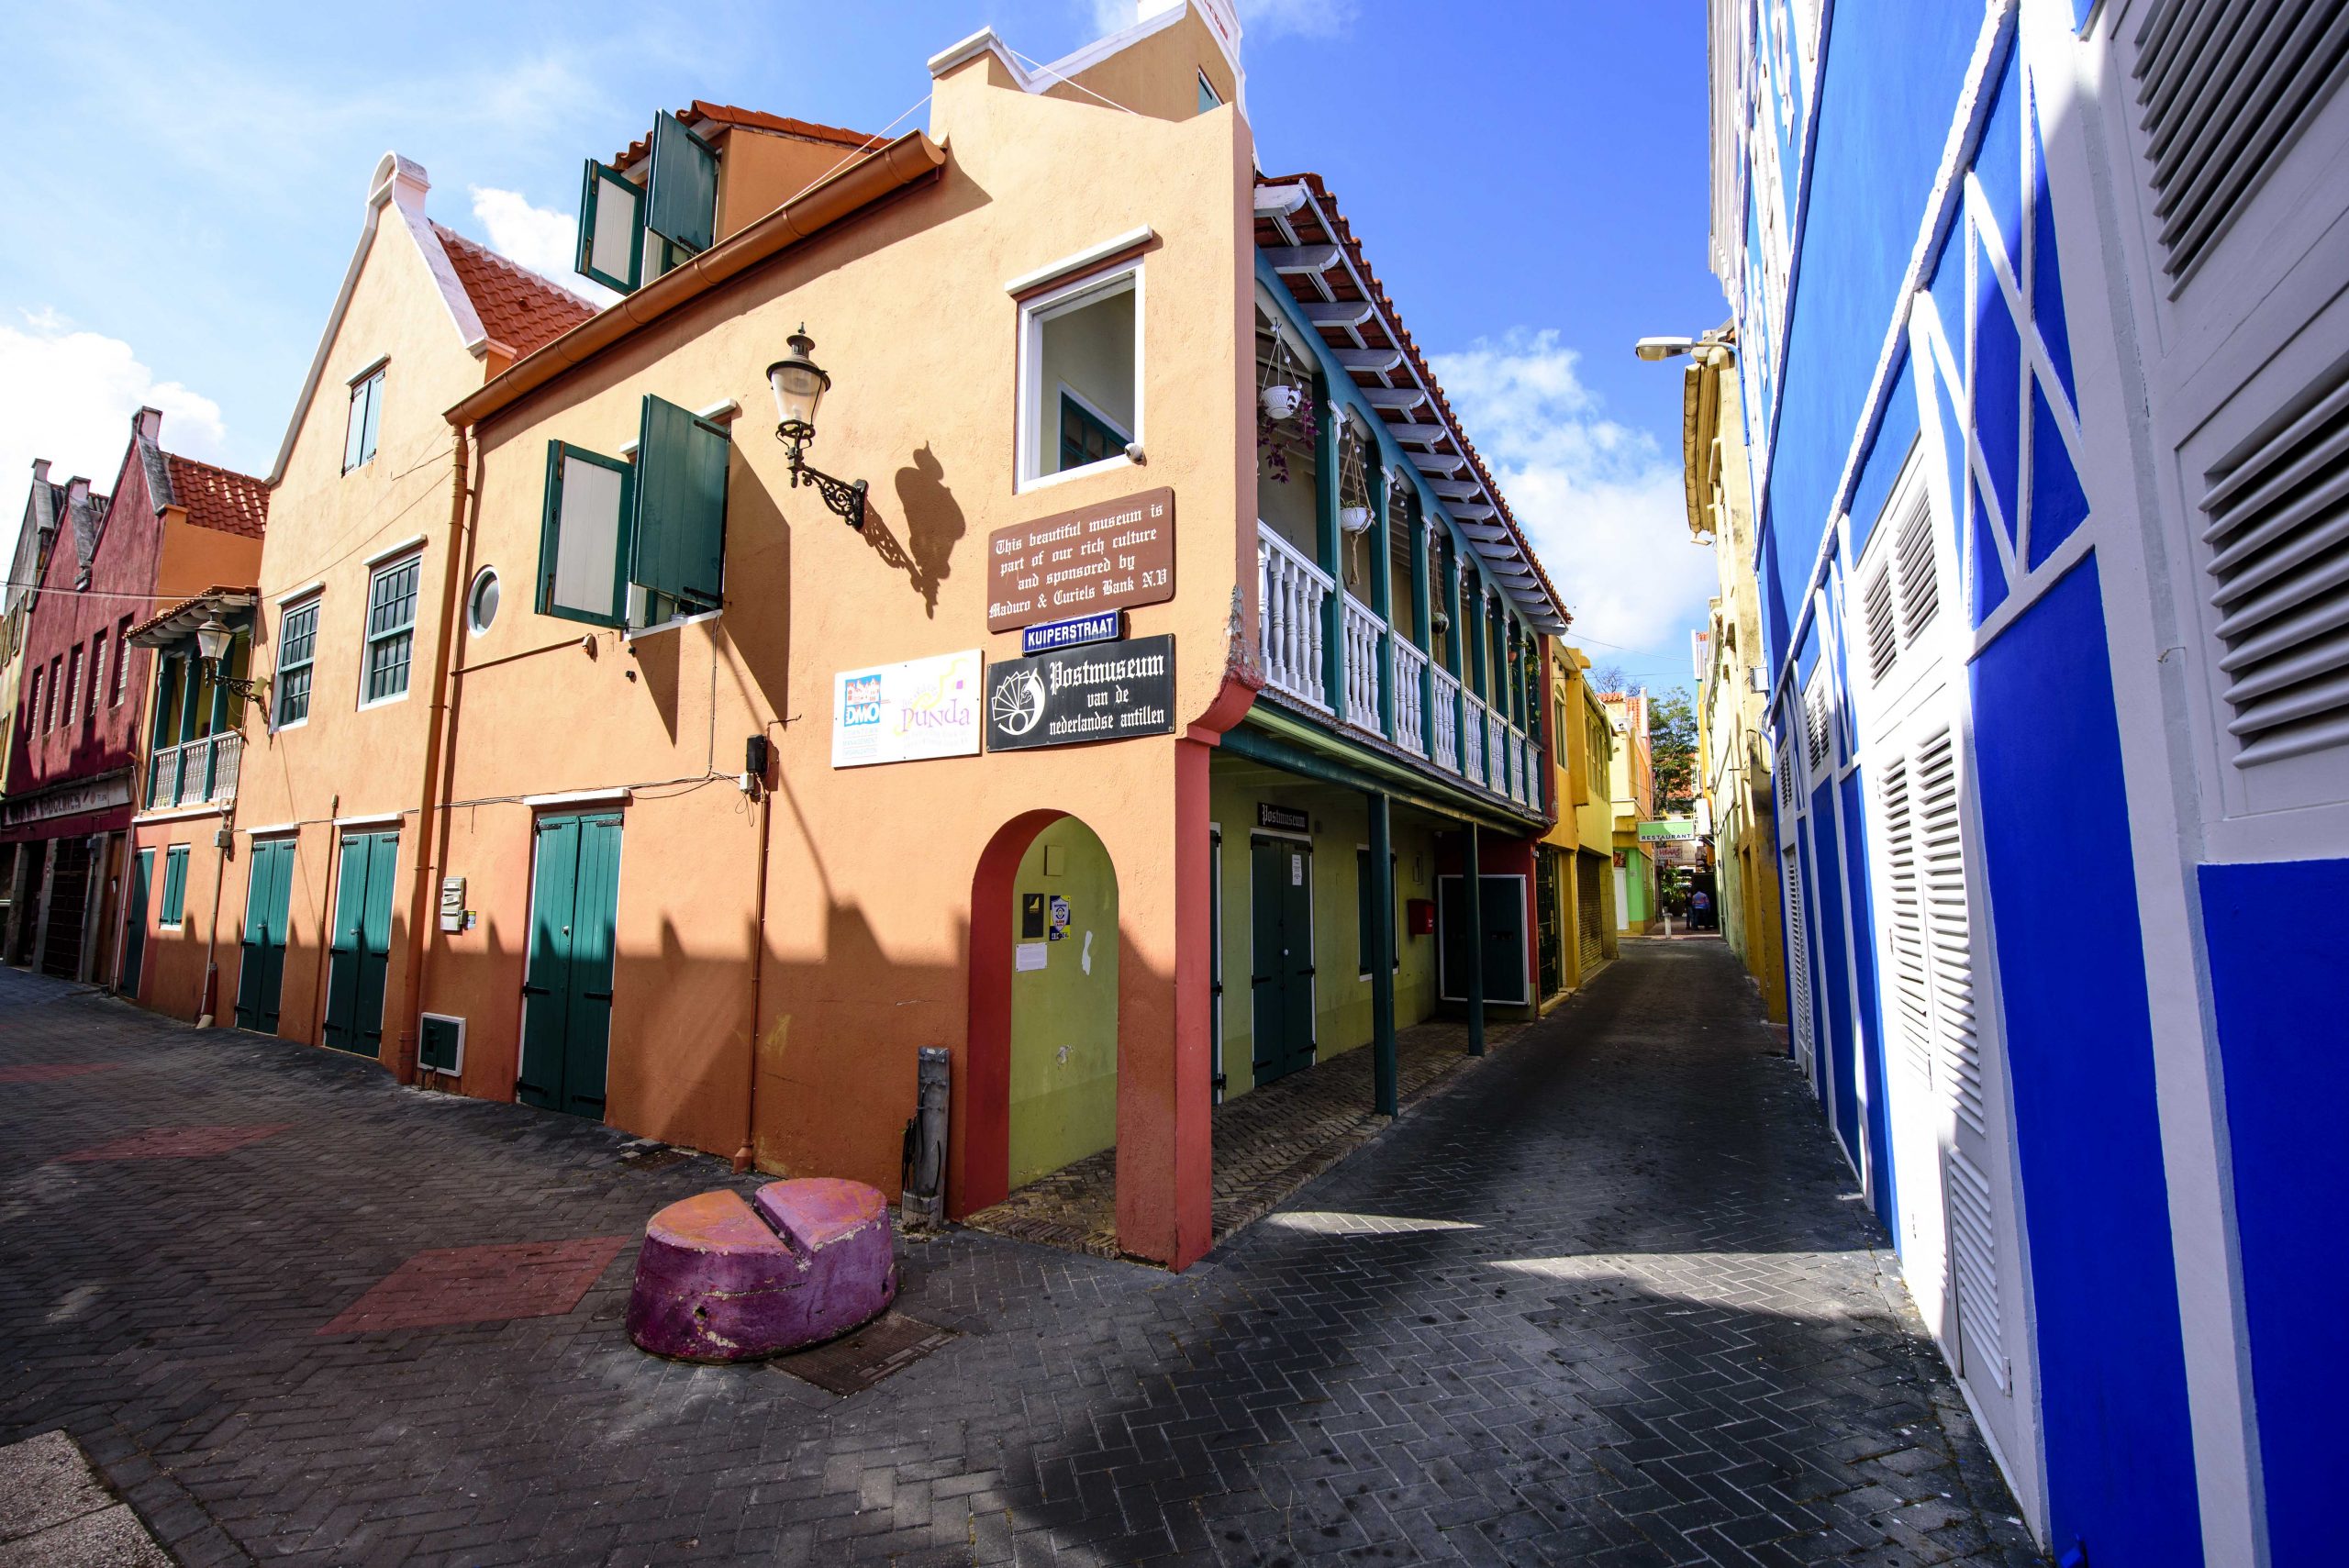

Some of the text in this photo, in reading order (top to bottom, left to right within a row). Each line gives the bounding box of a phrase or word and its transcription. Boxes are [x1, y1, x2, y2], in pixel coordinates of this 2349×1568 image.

[996, 504, 1163, 555] This beautiful museum is
[1000, 528, 1157, 577] part of our rich culture
[1018, 554, 1136, 590] and sponsored by
[989, 602, 1030, 618] Maduro
[1037, 594, 1048, 608] &
[1053, 585, 1096, 606] Curiels
[1102, 576, 1135, 596] Bank
[1027, 617, 1114, 646] KUIPERSTRAAT
[1049, 654, 1164, 695] Postmuseum
[1087, 685, 1130, 707] van de
[846, 703, 880, 725] DMO
[1049, 706, 1164, 736] nederlandse antillen
[1262, 804, 1306, 828] Postmuseum
